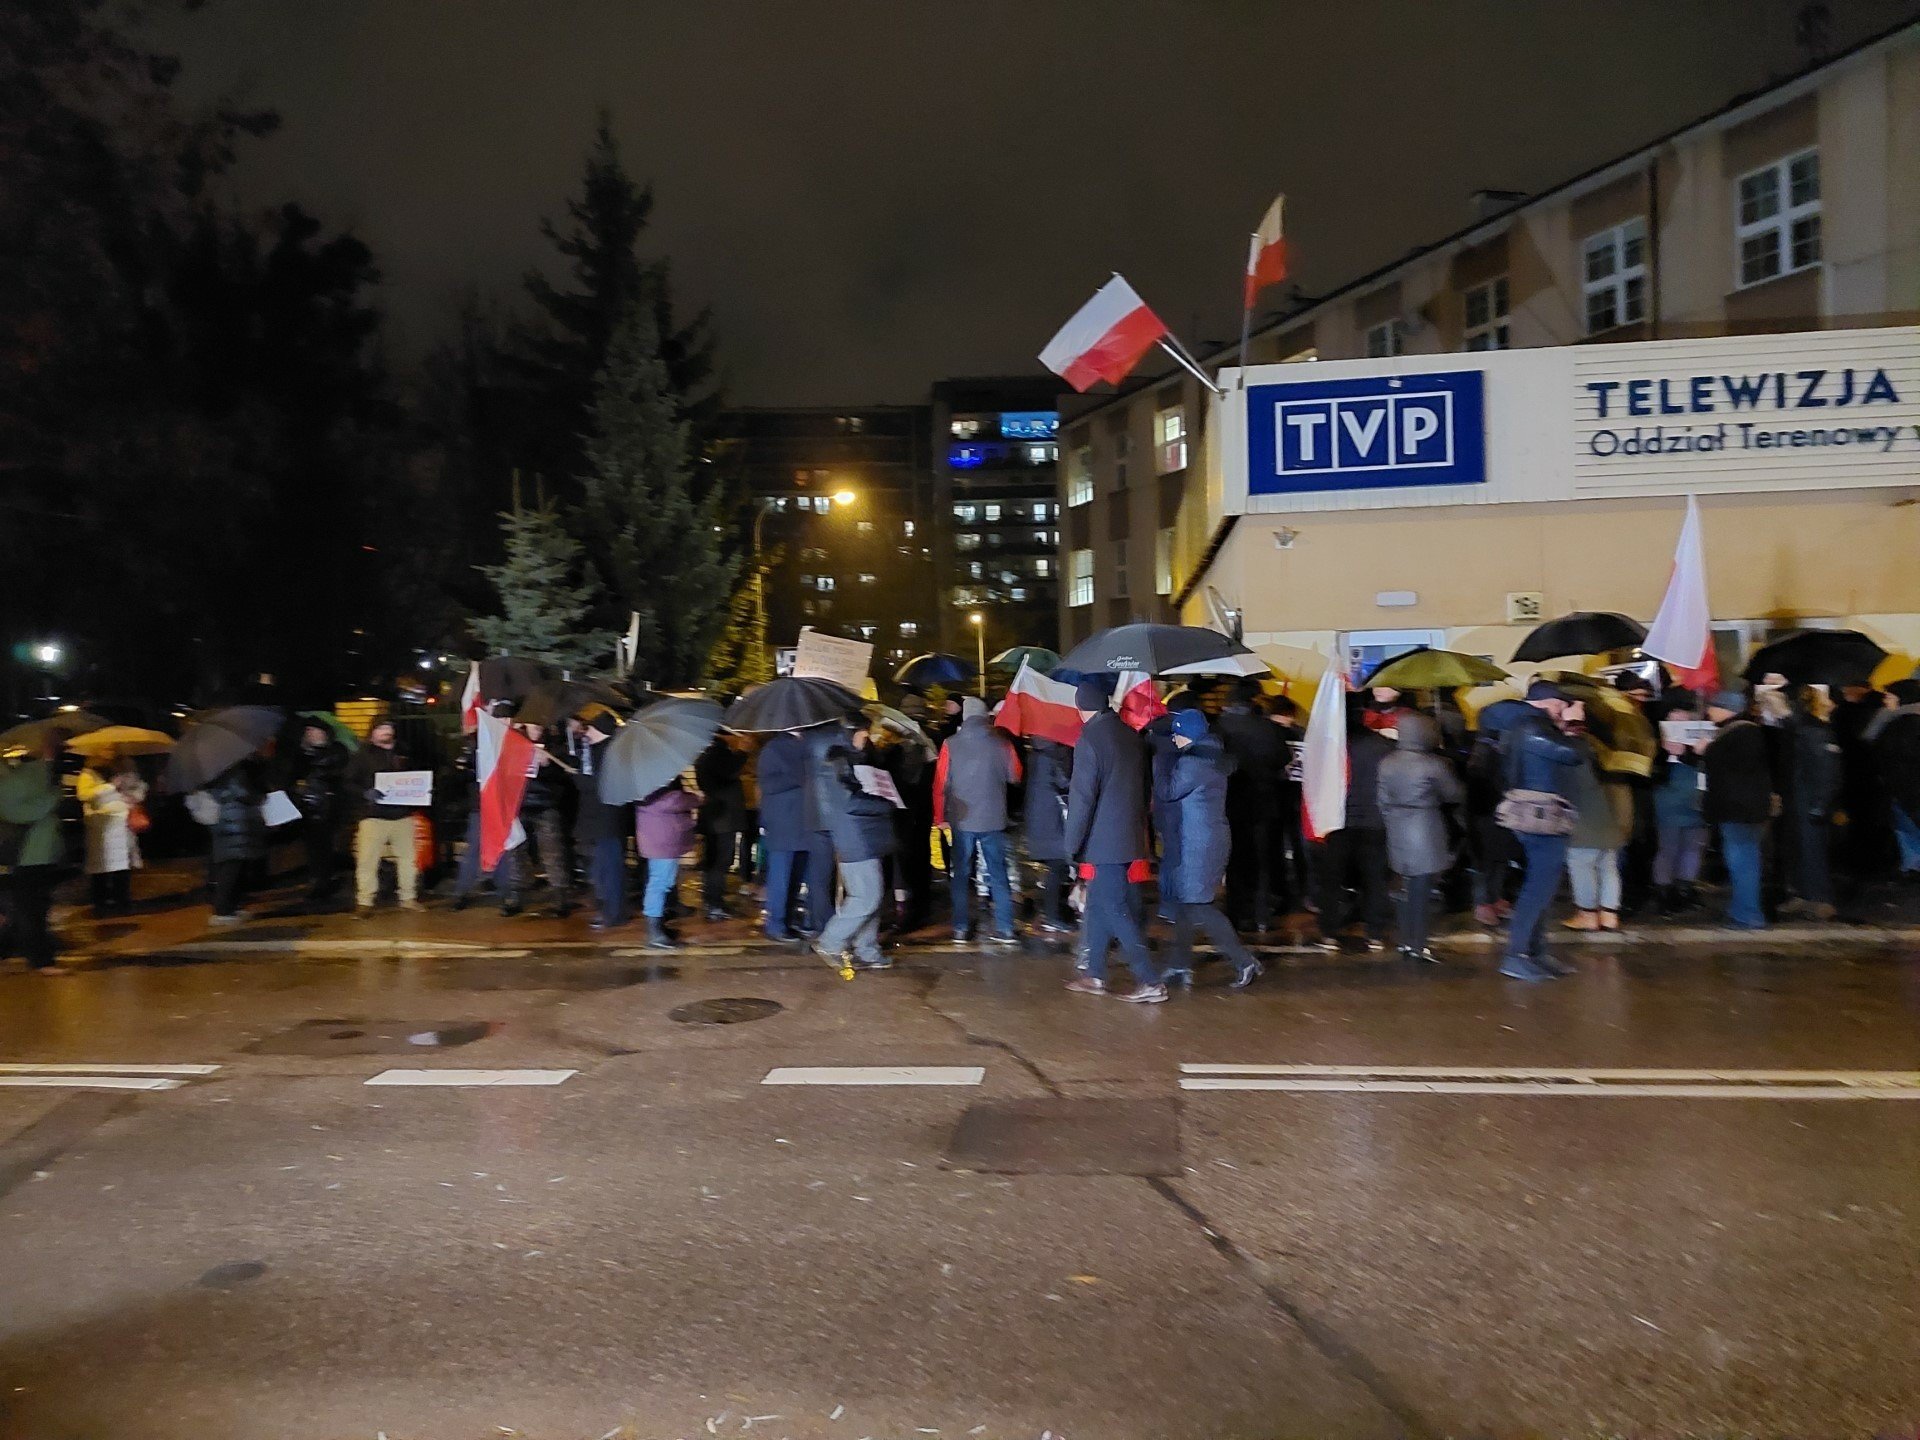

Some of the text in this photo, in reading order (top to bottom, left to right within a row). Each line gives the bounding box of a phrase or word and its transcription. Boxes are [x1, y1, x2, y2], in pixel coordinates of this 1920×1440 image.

[1586, 368, 1900, 418] TELEWIZJA
[1286, 406, 1439, 461] TVP
[1591, 422, 1726, 457] Oddział
[1737, 422, 1901, 452] Terenowy
